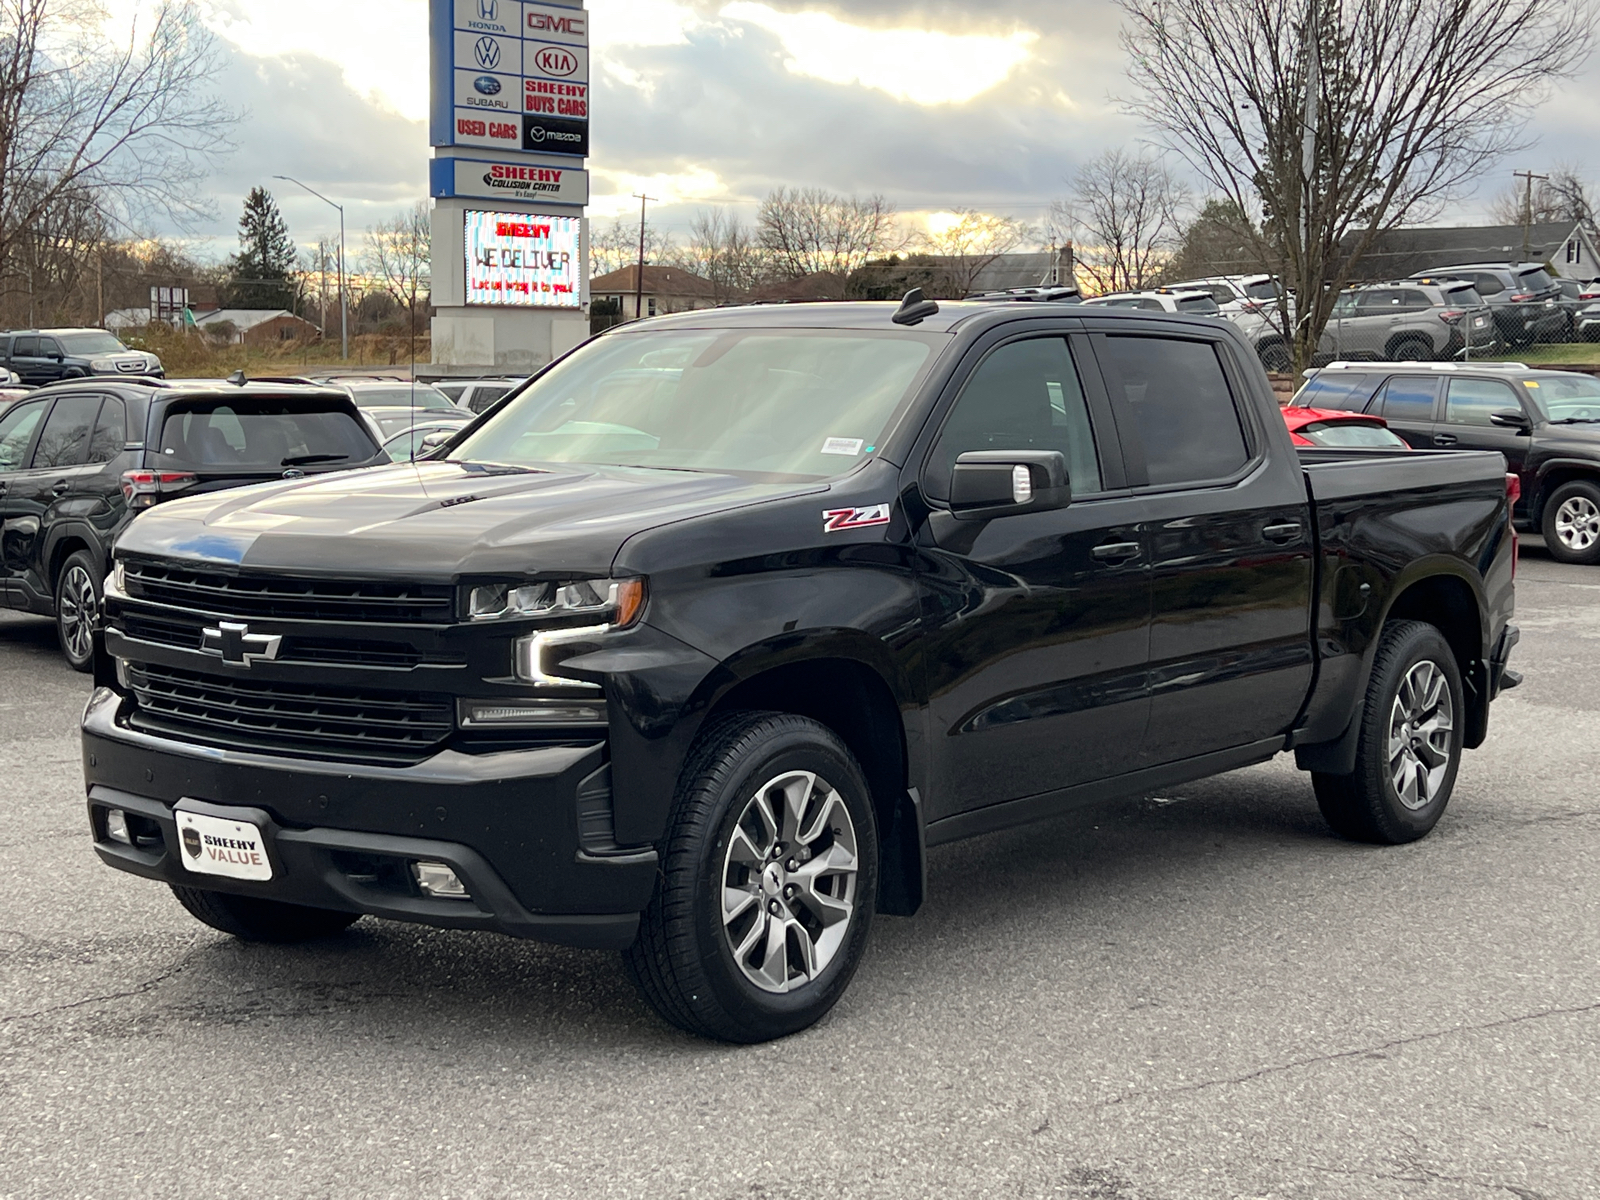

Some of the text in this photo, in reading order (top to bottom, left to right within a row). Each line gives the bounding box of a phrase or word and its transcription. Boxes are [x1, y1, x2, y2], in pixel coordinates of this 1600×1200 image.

[468, 20, 507, 33] HONDA
[527, 11, 584, 36] GMC
[542, 52, 571, 71] KIA
[525, 80, 587, 98] SHEEHY
[466, 97, 508, 109] SUBARU
[526, 94, 587, 117] BUYS CARS
[457, 119, 517, 140] USED CARS
[492, 165, 562, 182] SHEEHY
[492, 180, 561, 192] COLLISION CENTER
[501, 250, 570, 270] DELIVER
[203, 835, 256, 850] SHEEHY
[206, 847, 263, 865] VALUE
